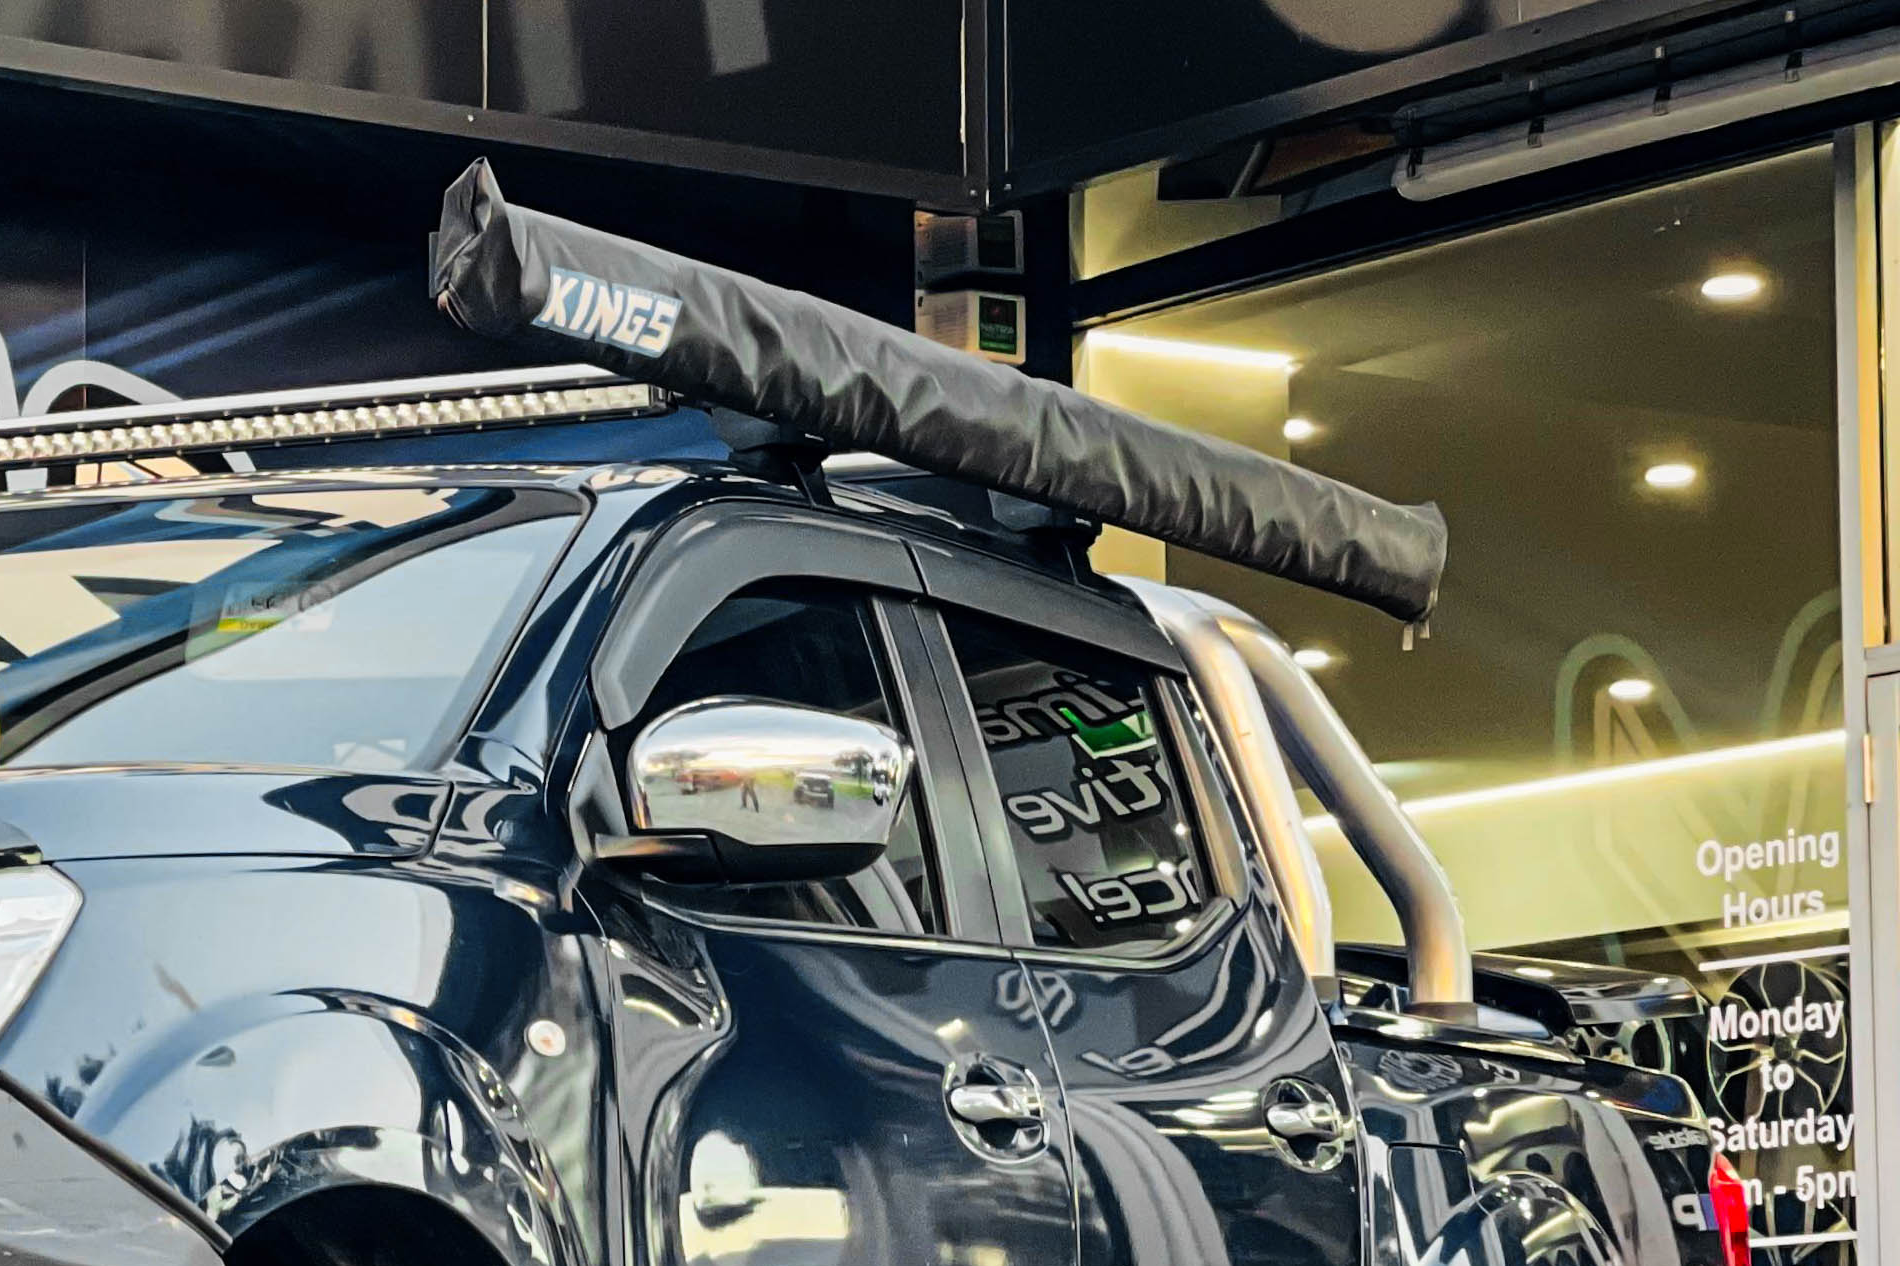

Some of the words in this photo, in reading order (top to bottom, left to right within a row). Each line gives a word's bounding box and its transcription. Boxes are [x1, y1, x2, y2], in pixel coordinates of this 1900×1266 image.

[539, 273, 677, 351] KINGS
[1697, 828, 1841, 880] Opening
[1723, 884, 1824, 929] Hours
[1708, 996, 1845, 1042] Monday
[1760, 1057, 1795, 1093] to
[1708, 1108, 1855, 1155] Saturday
